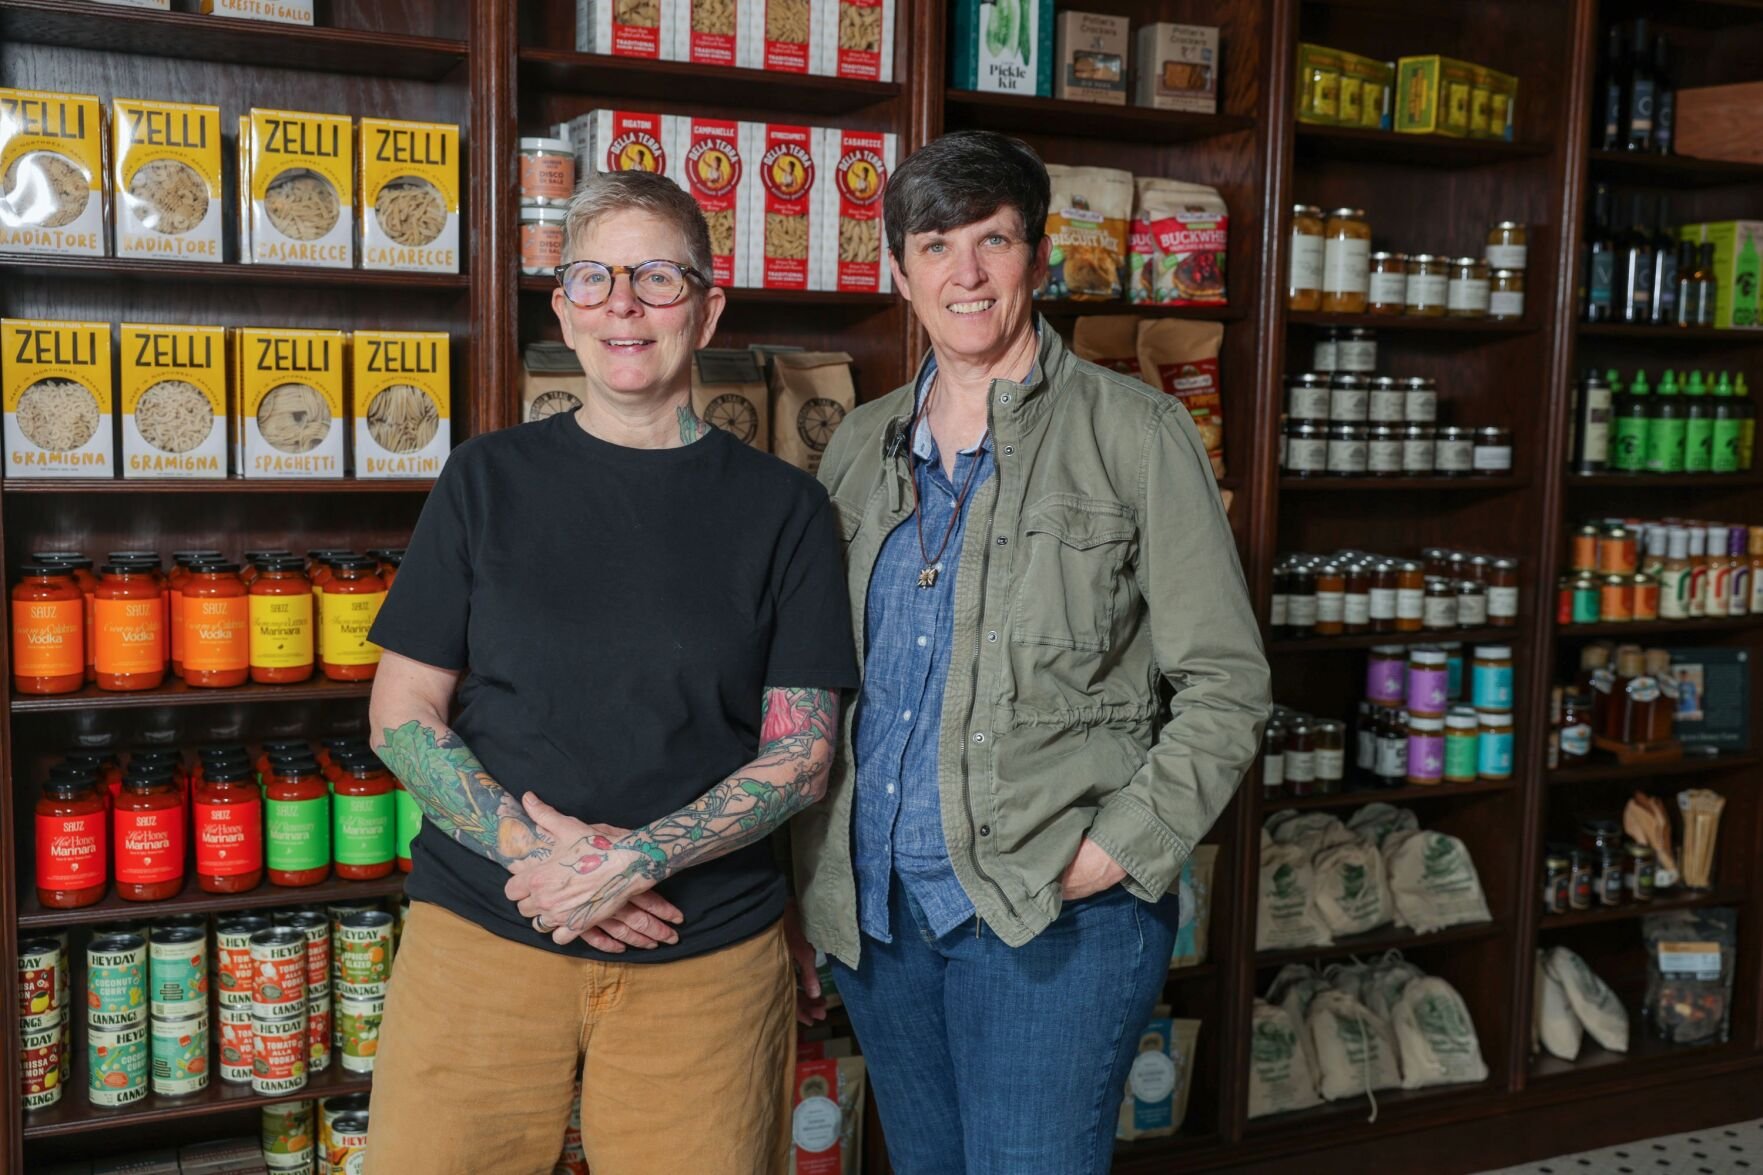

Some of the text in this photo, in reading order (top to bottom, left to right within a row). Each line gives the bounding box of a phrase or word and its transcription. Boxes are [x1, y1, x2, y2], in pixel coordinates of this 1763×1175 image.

[278, 6, 311, 21] GALLO
[989, 64, 1026, 80] Pickle
[1, 98, 85, 139] ZELLI
[128, 109, 206, 149] ZELLI
[694, 126, 735, 137] CAMPANELLE
[265, 119, 338, 157] ZELLI
[376, 129, 446, 165] ZELLI
[611, 132, 662, 156] DELLA TERRA
[689, 139, 739, 163] DELLA TERRA
[764, 144, 811, 168] DELLA TERRA
[1160, 230, 1227, 247] BUCKWHE
[259, 242, 347, 261] CASARECCE
[368, 248, 453, 266] CASARECCE
[16, 329, 96, 365] ZELLI
[135, 333, 211, 368] ZELLI
[257, 338, 329, 371] ZELLI
[367, 341, 437, 373] ZELLI
[31, 606, 57, 618] SAUZ
[126, 604, 150, 616] SAUZ
[203, 602, 228, 615] SAUZ
[122, 631, 155, 642] Vodka
[199, 629, 232, 640] Vodka
[260, 626, 300, 636] Marinara
[27, 633, 63, 644] Vodka
[211, 810, 231, 820] SAUZ
[276, 805, 299, 817] SAUZ
[63, 821, 84, 832] SAUZ
[136, 816, 157, 827] SAUZ
[343, 824, 384, 834] Marinara
[71, 836, 95, 847] Honey
[144, 831, 168, 841] Honey
[202, 832, 244, 843] Marinara
[270, 831, 310, 841] Marinara
[125, 839, 170, 850] Marinara
[51, 844, 96, 857] Marinara
[226, 937, 250, 948] HEY
[18, 958, 41, 969] DAY
[92, 953, 136, 967] HEYDAY
[233, 955, 251, 963] TOM
[235, 970, 251, 978] VOD
[95, 977, 132, 987] COCONUT
[100, 986, 127, 995] CURRY
[228, 995, 250, 1004] CANN
[92, 1013, 137, 1024] CANNINGS
[231, 1013, 252, 1022] HEY
[260, 1021, 301, 1034] HEYDAY
[22, 1033, 53, 1048] YDAY
[117, 1028, 146, 1044] HEYD
[267, 1041, 297, 1050] TOMATO
[269, 1055, 295, 1064] VODKA
[260, 1078, 302, 1090] CANNINGS
[342, 1136, 367, 1146] HEY
